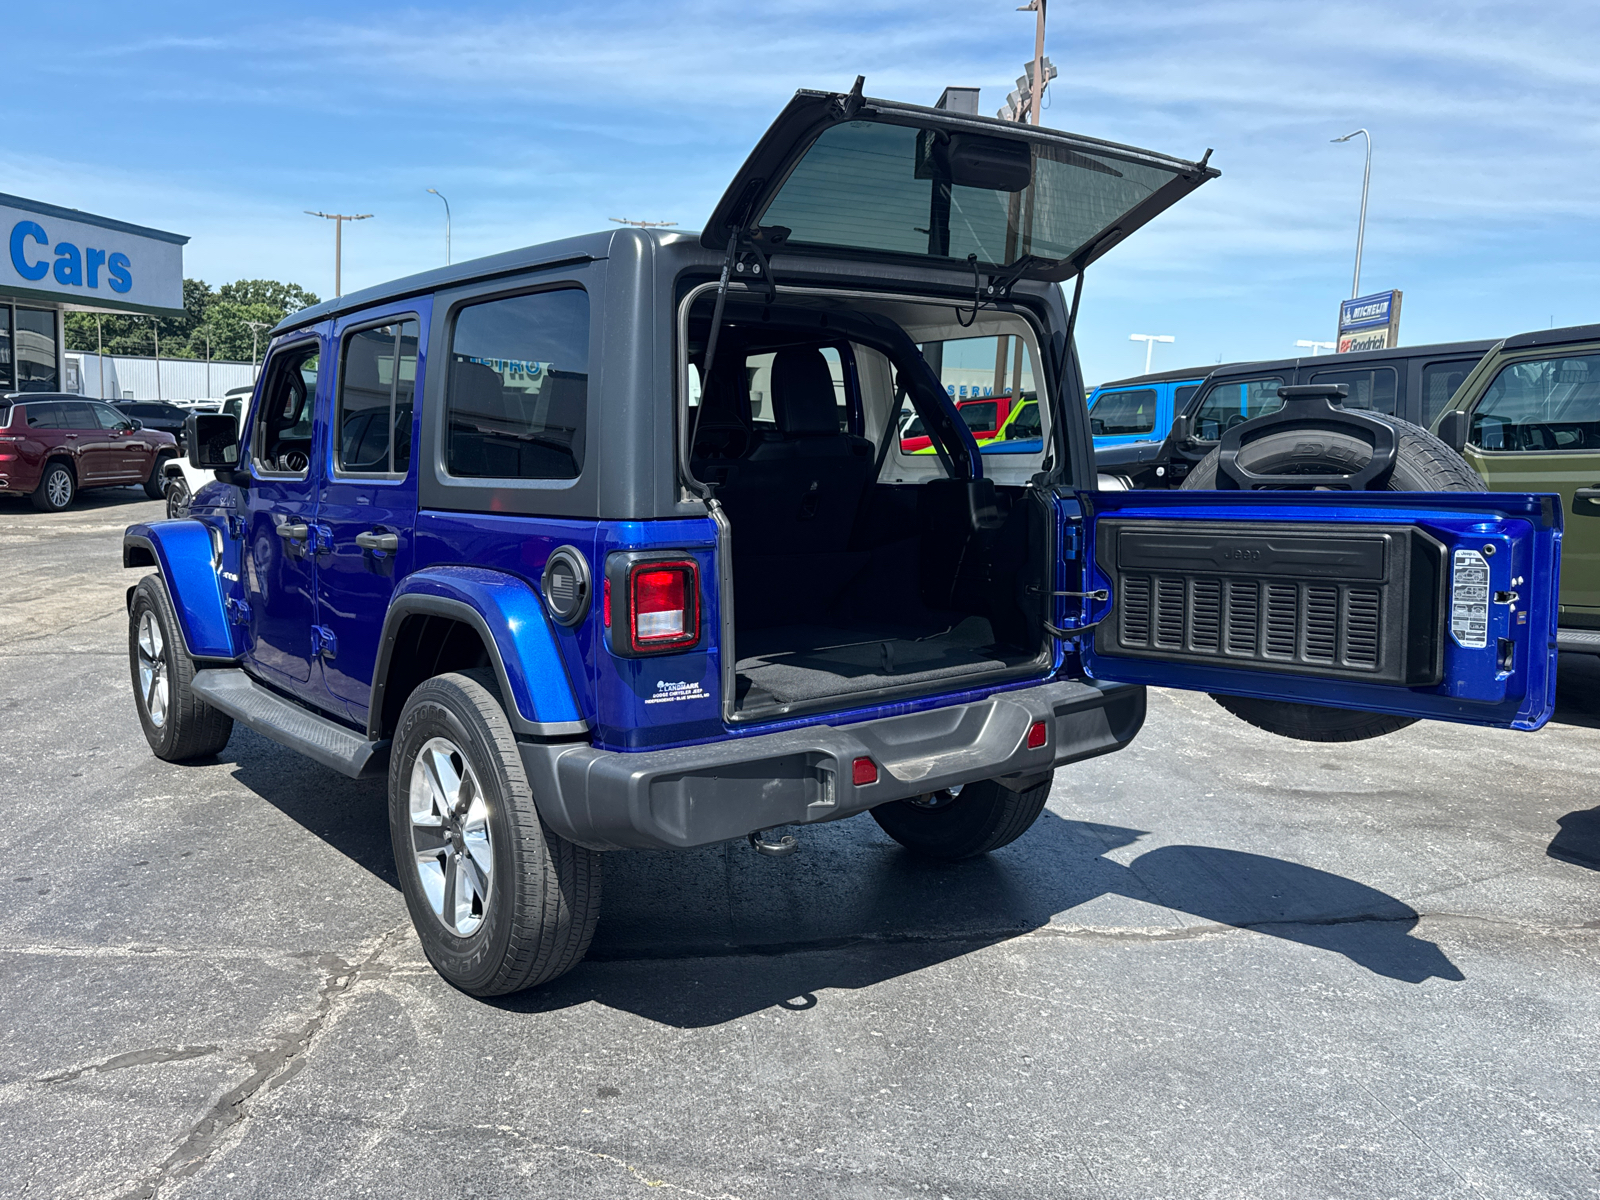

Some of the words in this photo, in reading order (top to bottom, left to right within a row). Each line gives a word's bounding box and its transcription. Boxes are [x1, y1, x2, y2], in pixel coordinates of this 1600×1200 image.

[9, 220, 133, 294] Cars
[1353, 301, 1389, 318] MICHELIN
[1223, 547, 1260, 563] Jeep
